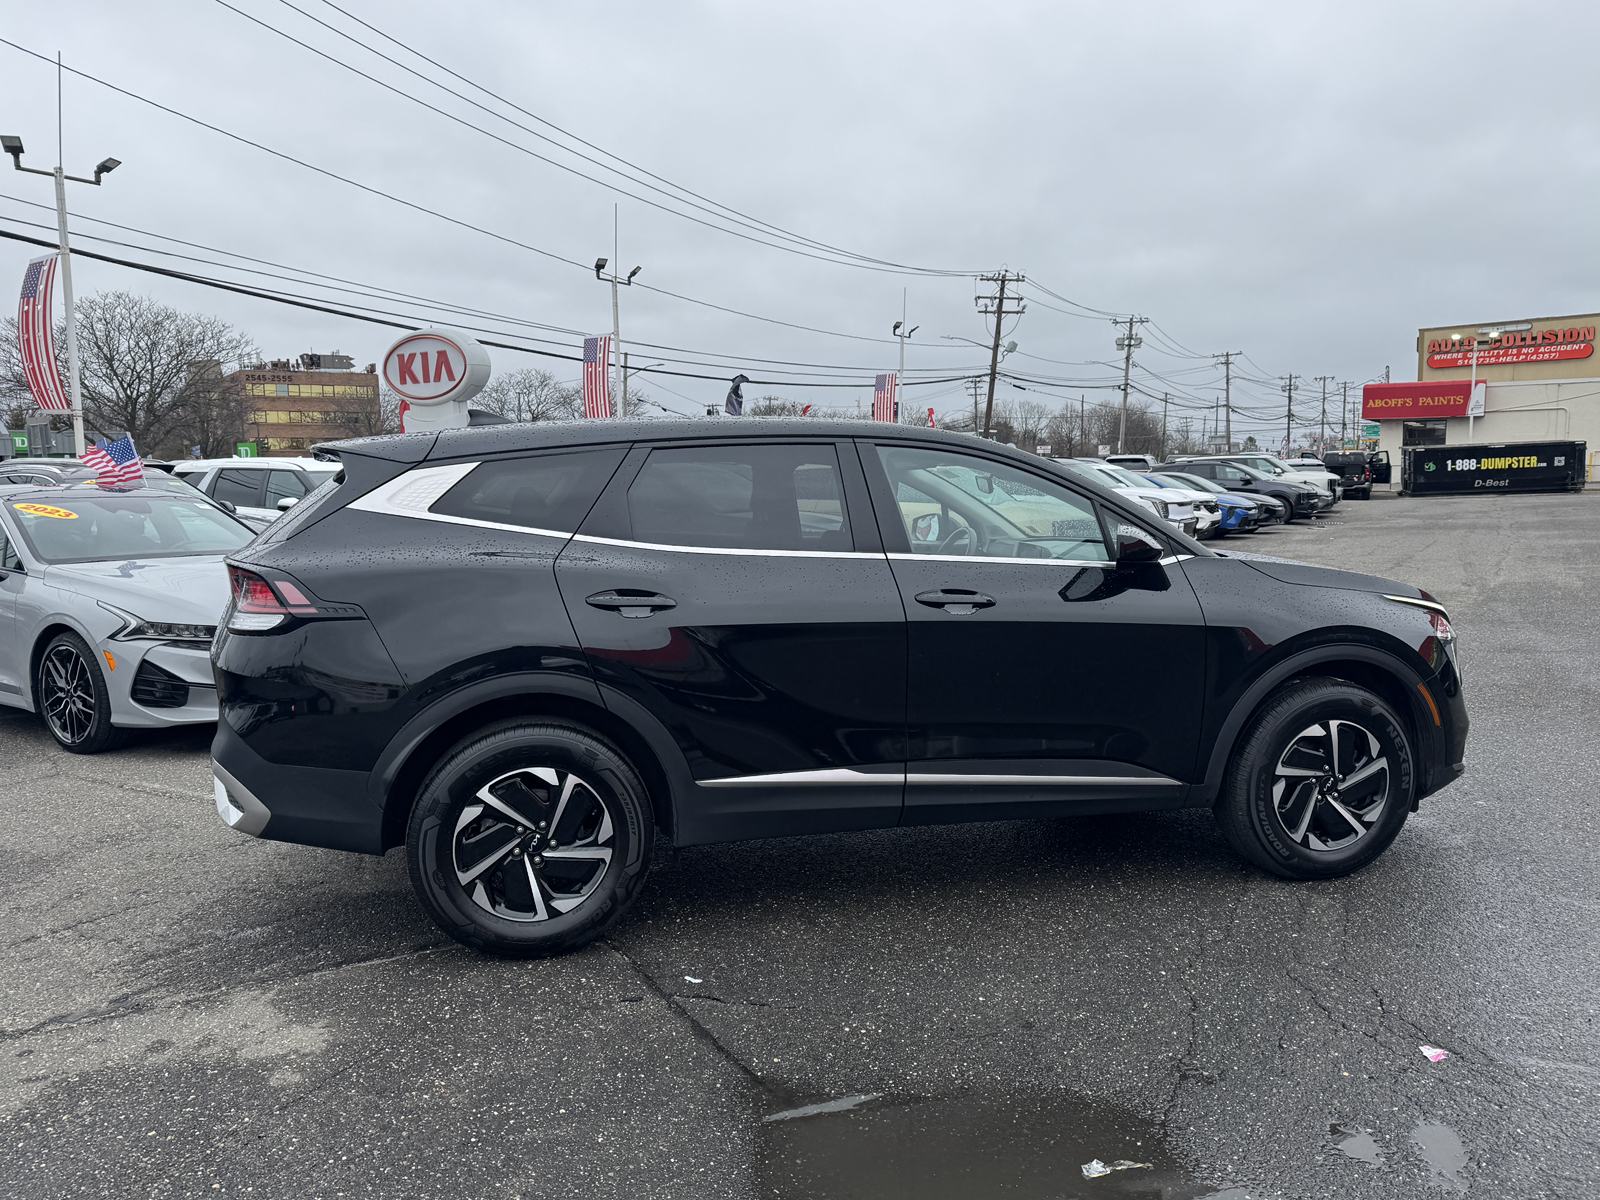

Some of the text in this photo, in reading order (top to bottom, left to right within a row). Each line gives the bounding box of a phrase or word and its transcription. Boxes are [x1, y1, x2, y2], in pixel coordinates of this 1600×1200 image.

[1428, 336, 1476, 353] AUTO
[1489, 326, 1595, 349] COLLISION
[1434, 352, 1463, 361] WHERE
[1539, 343, 1586, 353] ACCIDENT
[1528, 352, 1559, 361] (4357)
[396, 349, 456, 385] KIA
[245, 374, 293, 382] 2545-2555
[1366, 395, 1464, 408] ABOFF'S PAINTS
[13, 437, 28, 447] TD
[238, 446, 251, 458] TD
[1474, 479, 1509, 487] D-Best
[19, 504, 73, 518] 2023
[1386, 725, 1410, 789] NEXEN
[1258, 800, 1290, 857] ROADIAN
